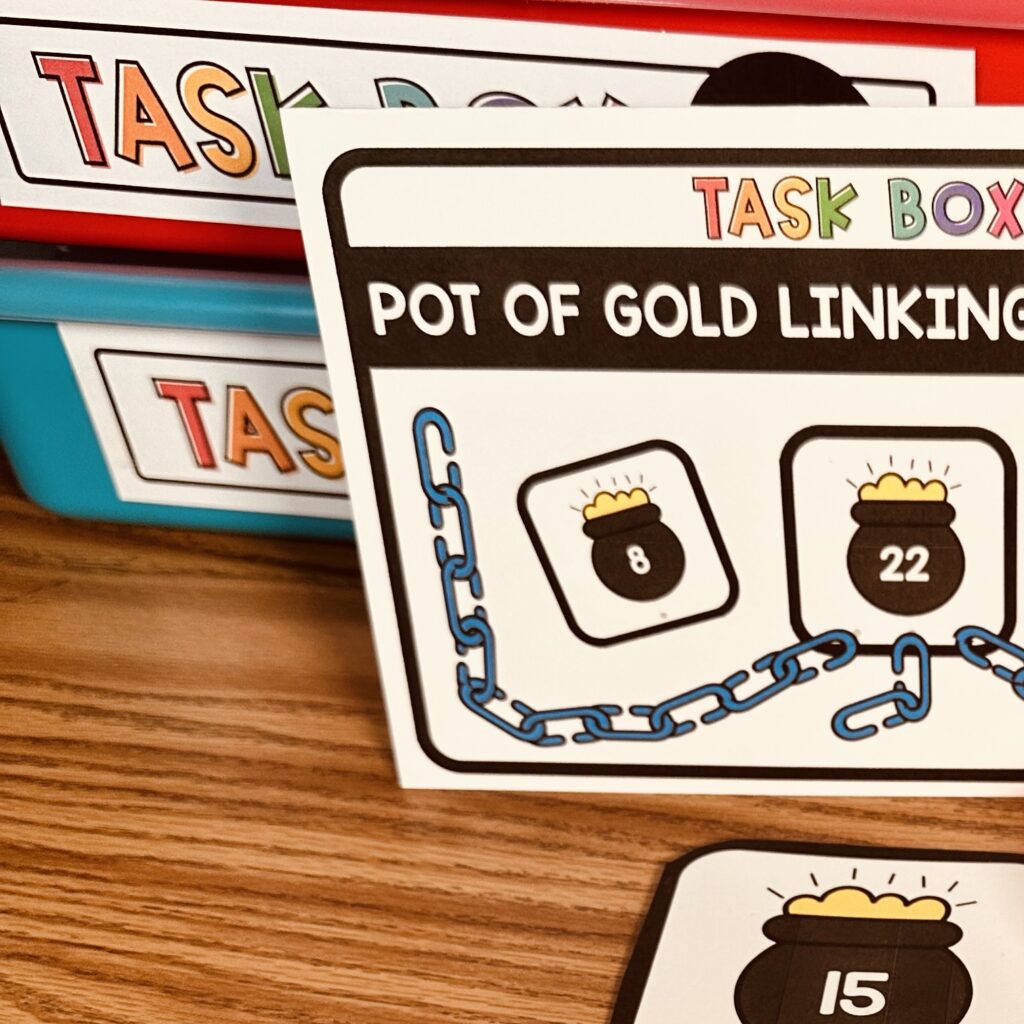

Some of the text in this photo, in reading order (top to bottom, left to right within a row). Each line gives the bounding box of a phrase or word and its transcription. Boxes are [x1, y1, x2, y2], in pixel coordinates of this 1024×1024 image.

[692, 176, 858, 241] TASK
[368, 281, 480, 336] POT
[503, 281, 580, 337] OF
[604, 282, 757, 338] GOLD
[626, 544, 651, 575] 8
[879, 546, 931, 583] 22
[819, 970, 889, 1017] 15
